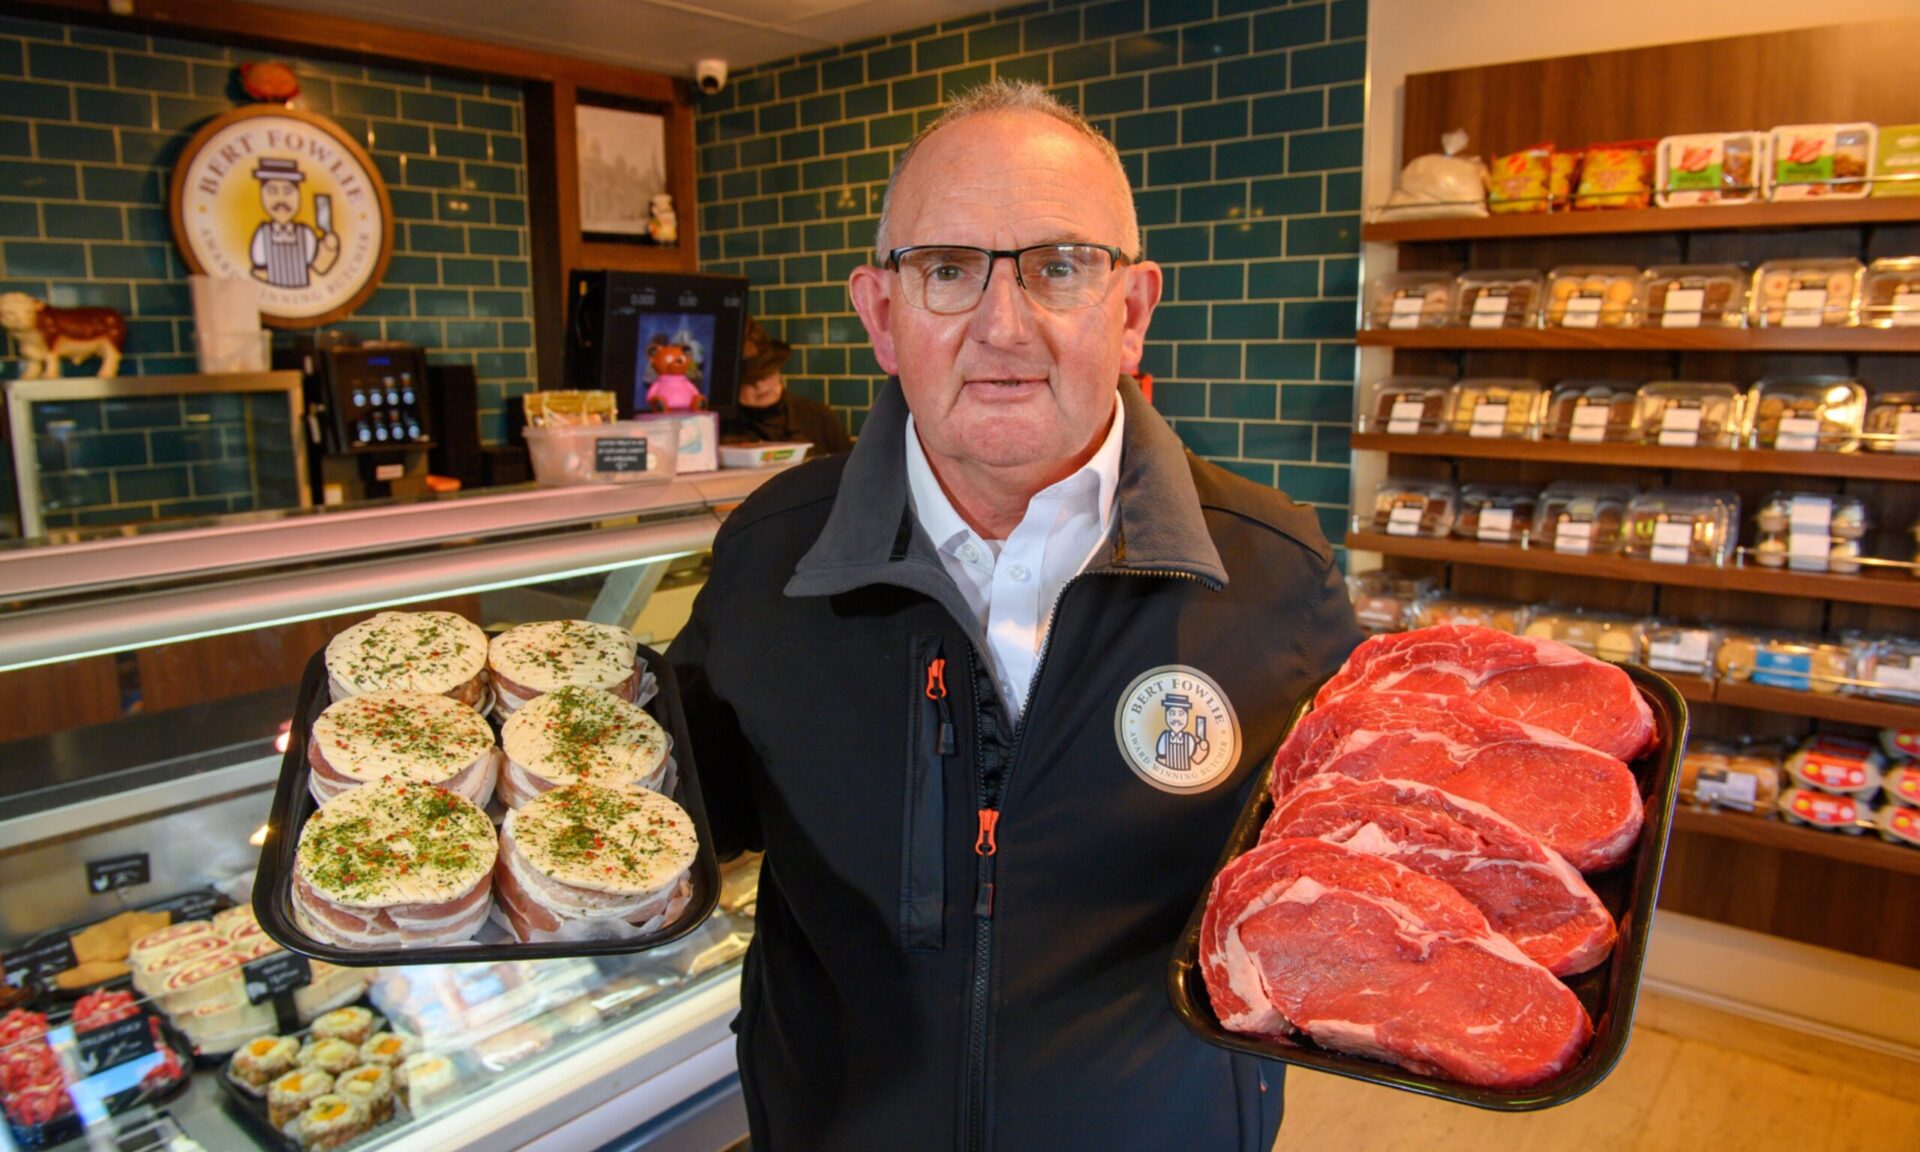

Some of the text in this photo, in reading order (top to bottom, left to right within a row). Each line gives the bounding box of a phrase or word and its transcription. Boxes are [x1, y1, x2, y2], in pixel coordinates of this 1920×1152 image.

[200, 129, 365, 205] BERT FOWLIE
[1131, 678, 1226, 725] BERT FOWLIE
[1130, 731, 1228, 781] AWARD WINNING BUTCHER
